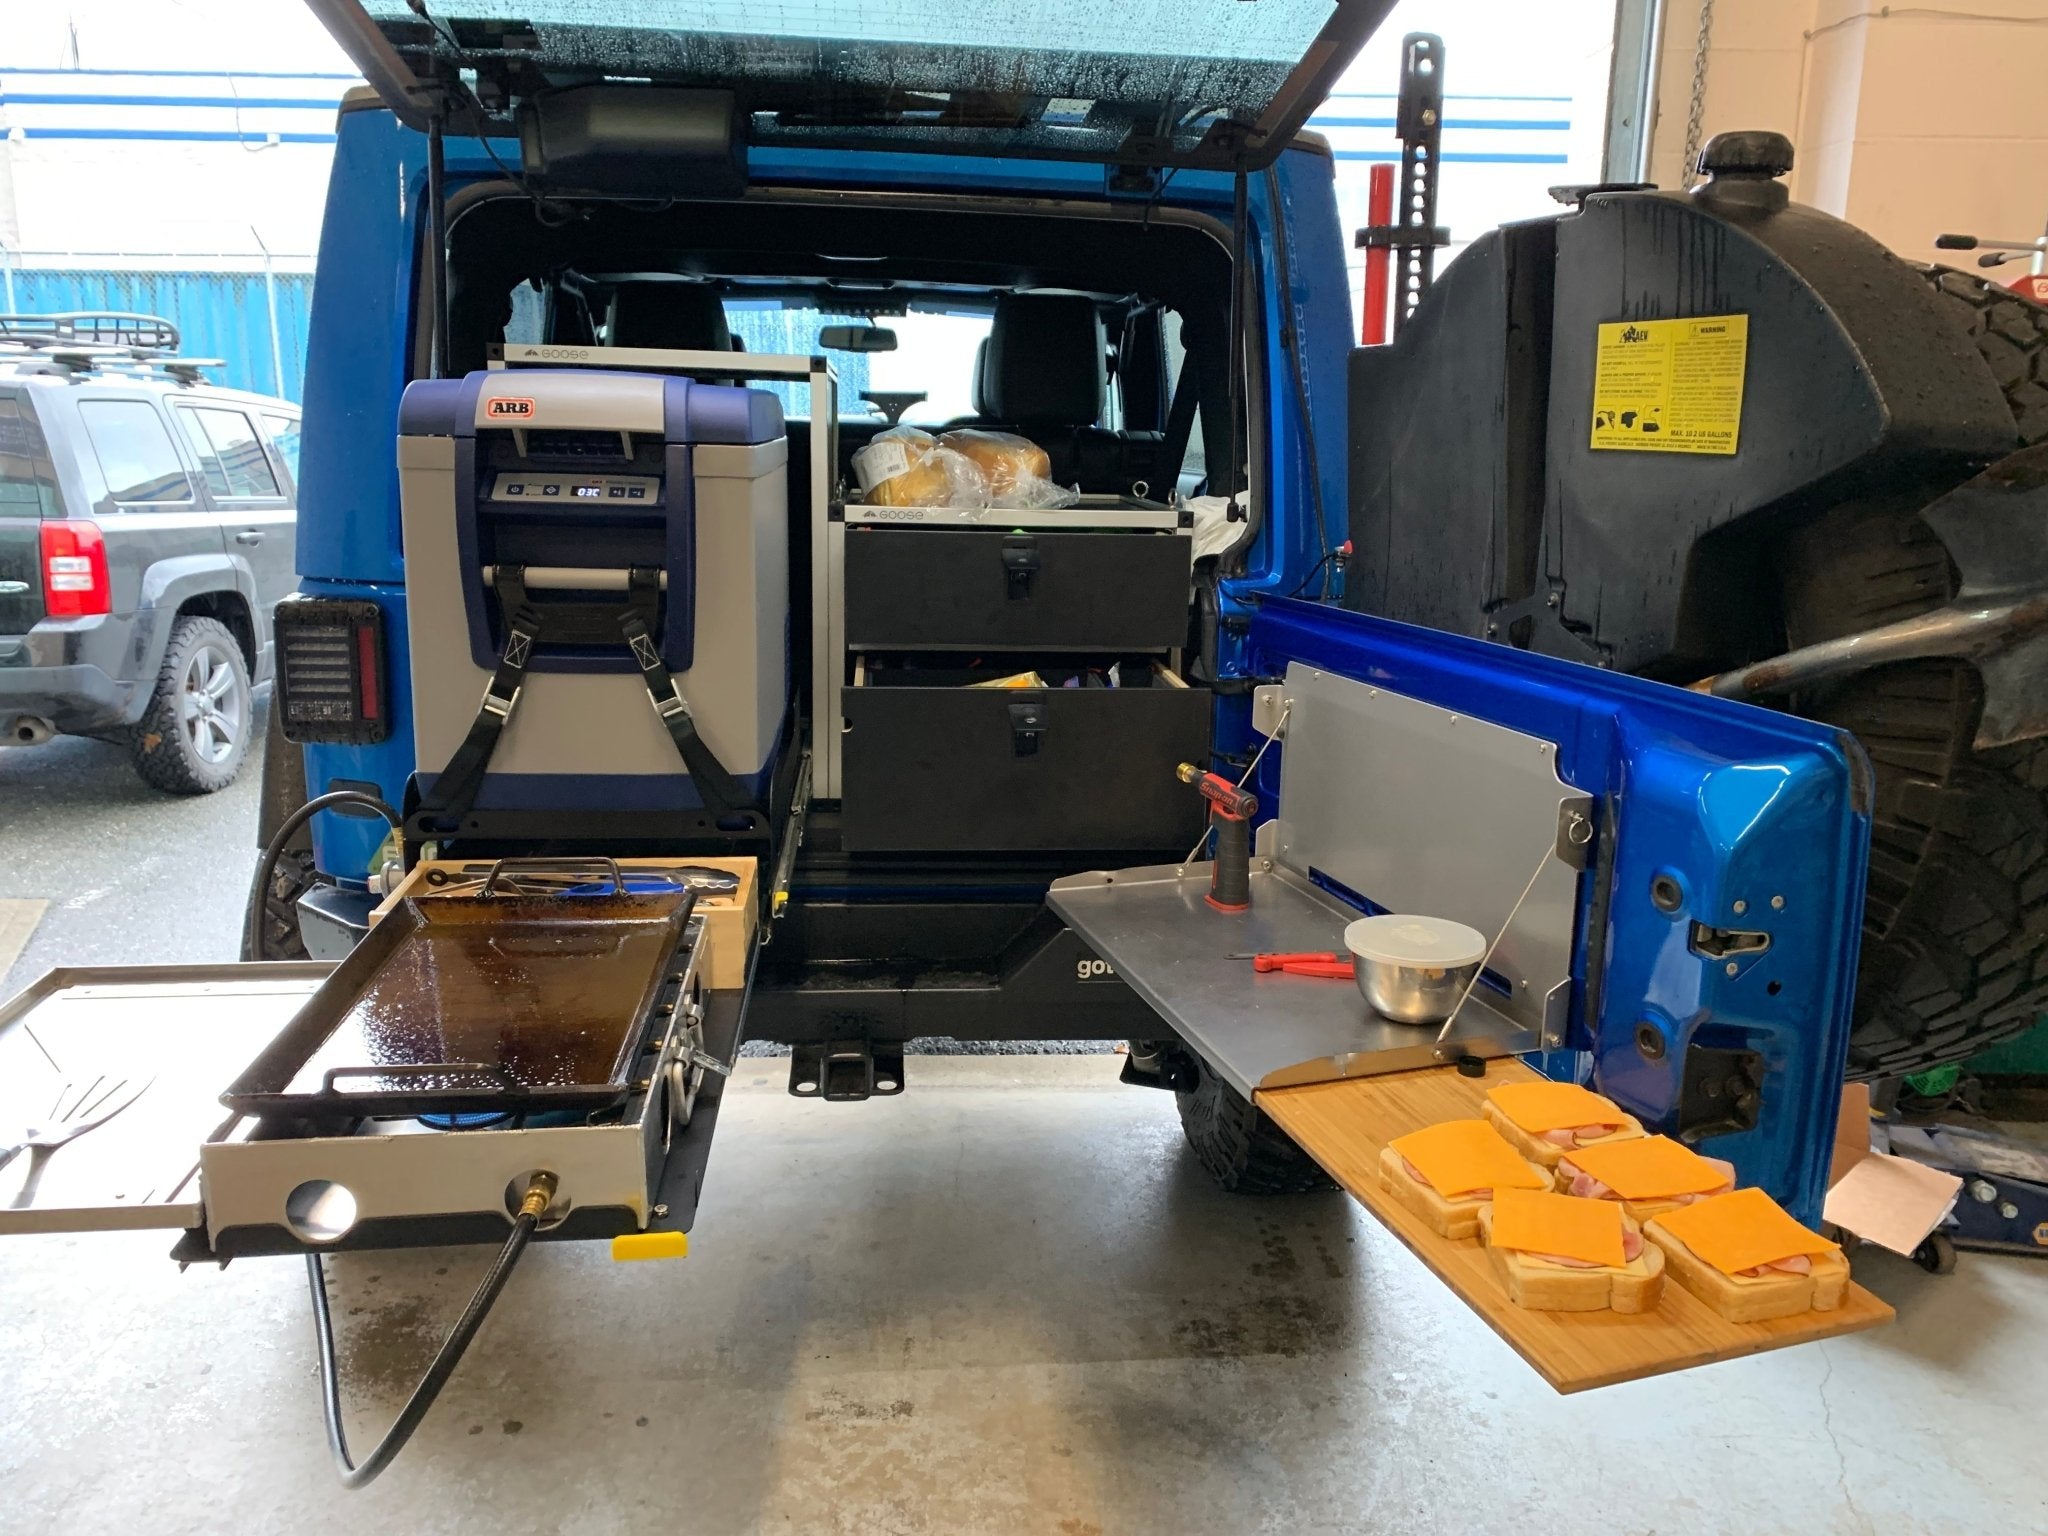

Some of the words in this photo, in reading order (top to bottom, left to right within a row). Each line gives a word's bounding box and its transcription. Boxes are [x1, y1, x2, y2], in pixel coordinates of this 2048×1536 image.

[1700, 326, 1726, 334] WARNING
[493, 402, 529, 413] ARB
[1200, 782, 1234, 806] Snap-on
